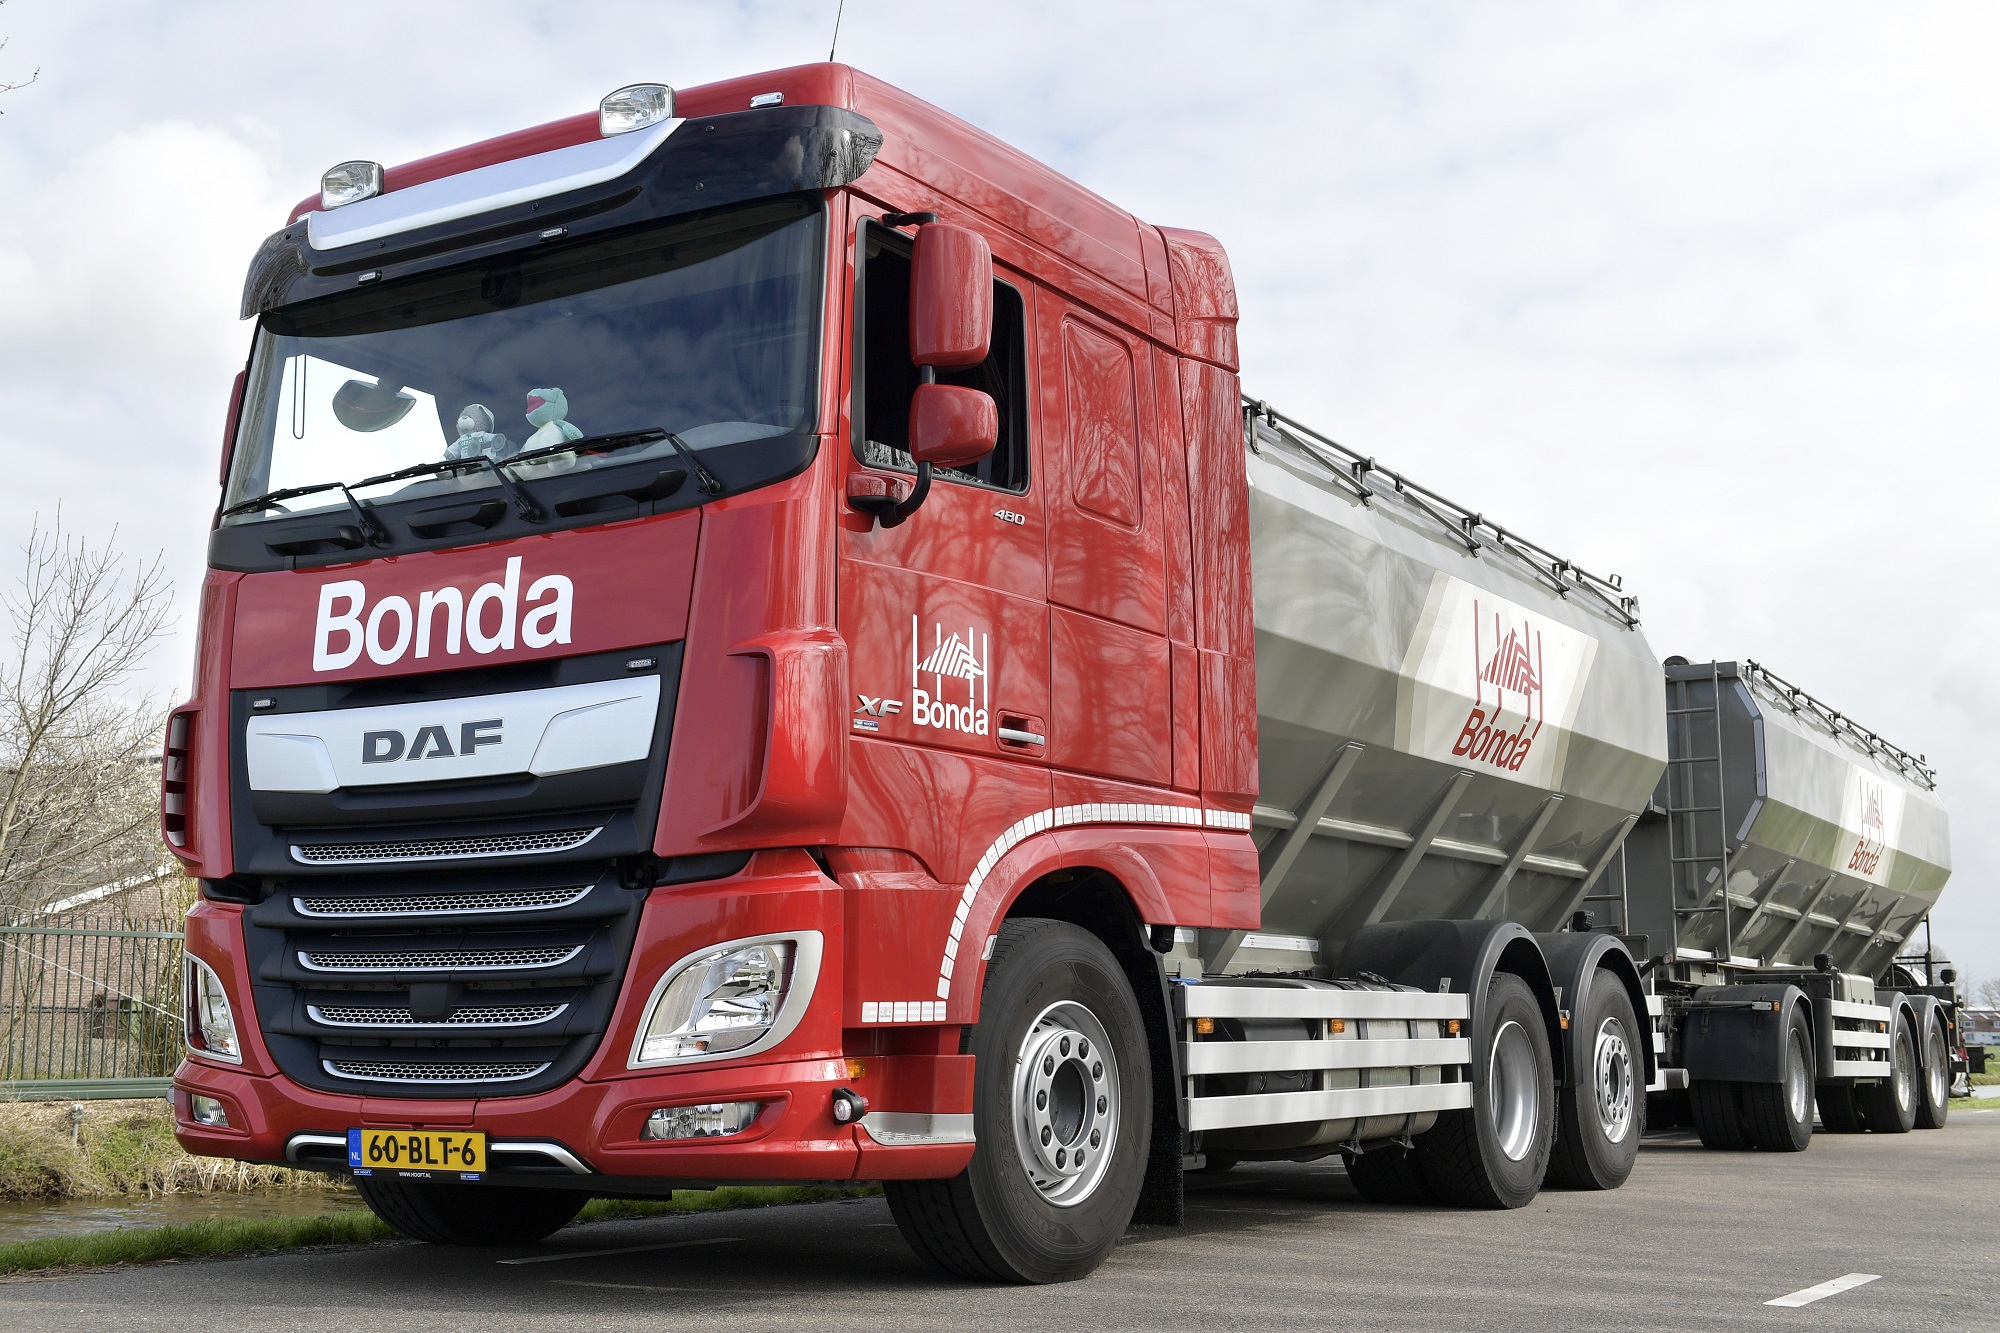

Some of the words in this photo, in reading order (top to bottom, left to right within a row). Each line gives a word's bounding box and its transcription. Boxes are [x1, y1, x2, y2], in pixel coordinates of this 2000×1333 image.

[993, 509, 1025, 525] 480
[313, 556, 574, 672] Bonda
[854, 694, 903, 717] XF
[912, 687, 989, 736] Bonda
[361, 718, 503, 765] DAF
[1451, 707, 1532, 772] Bonda
[1847, 840, 1880, 876] Bonda
[351, 1151, 361, 1161] NL
[368, 1134, 476, 1166] 60-BLT-6
